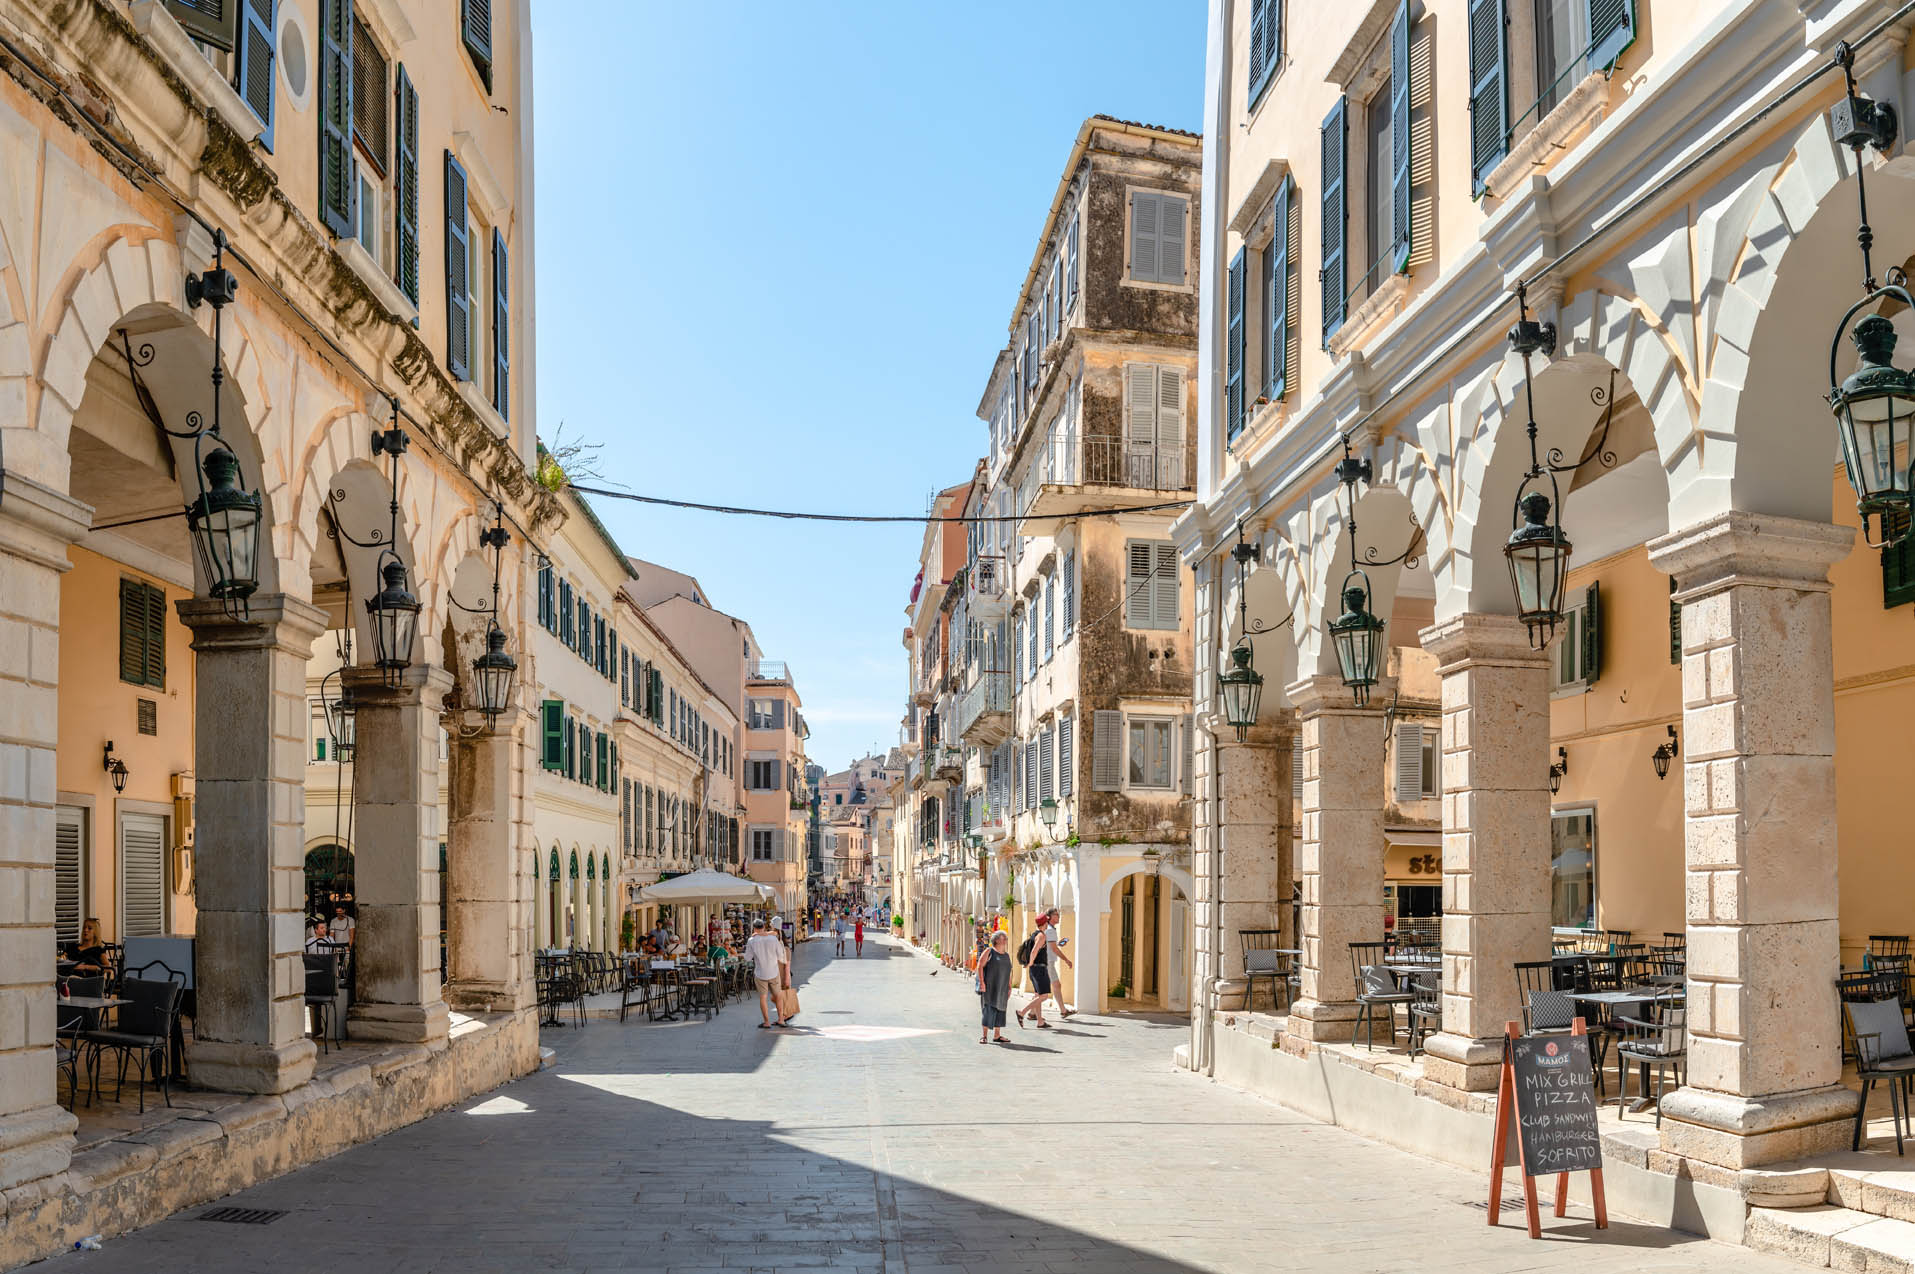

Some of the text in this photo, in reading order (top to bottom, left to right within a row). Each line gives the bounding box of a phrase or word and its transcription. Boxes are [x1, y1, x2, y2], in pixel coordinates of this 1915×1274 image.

[1526, 1072, 1592, 1089] MIX GRILL
[1534, 1092, 1591, 1108] PIZZA
[1521, 1114, 1551, 1127] CLUB
[1531, 1130, 1599, 1145] HAMBURGER
[1537, 1146, 1595, 1165] SOFRITO
